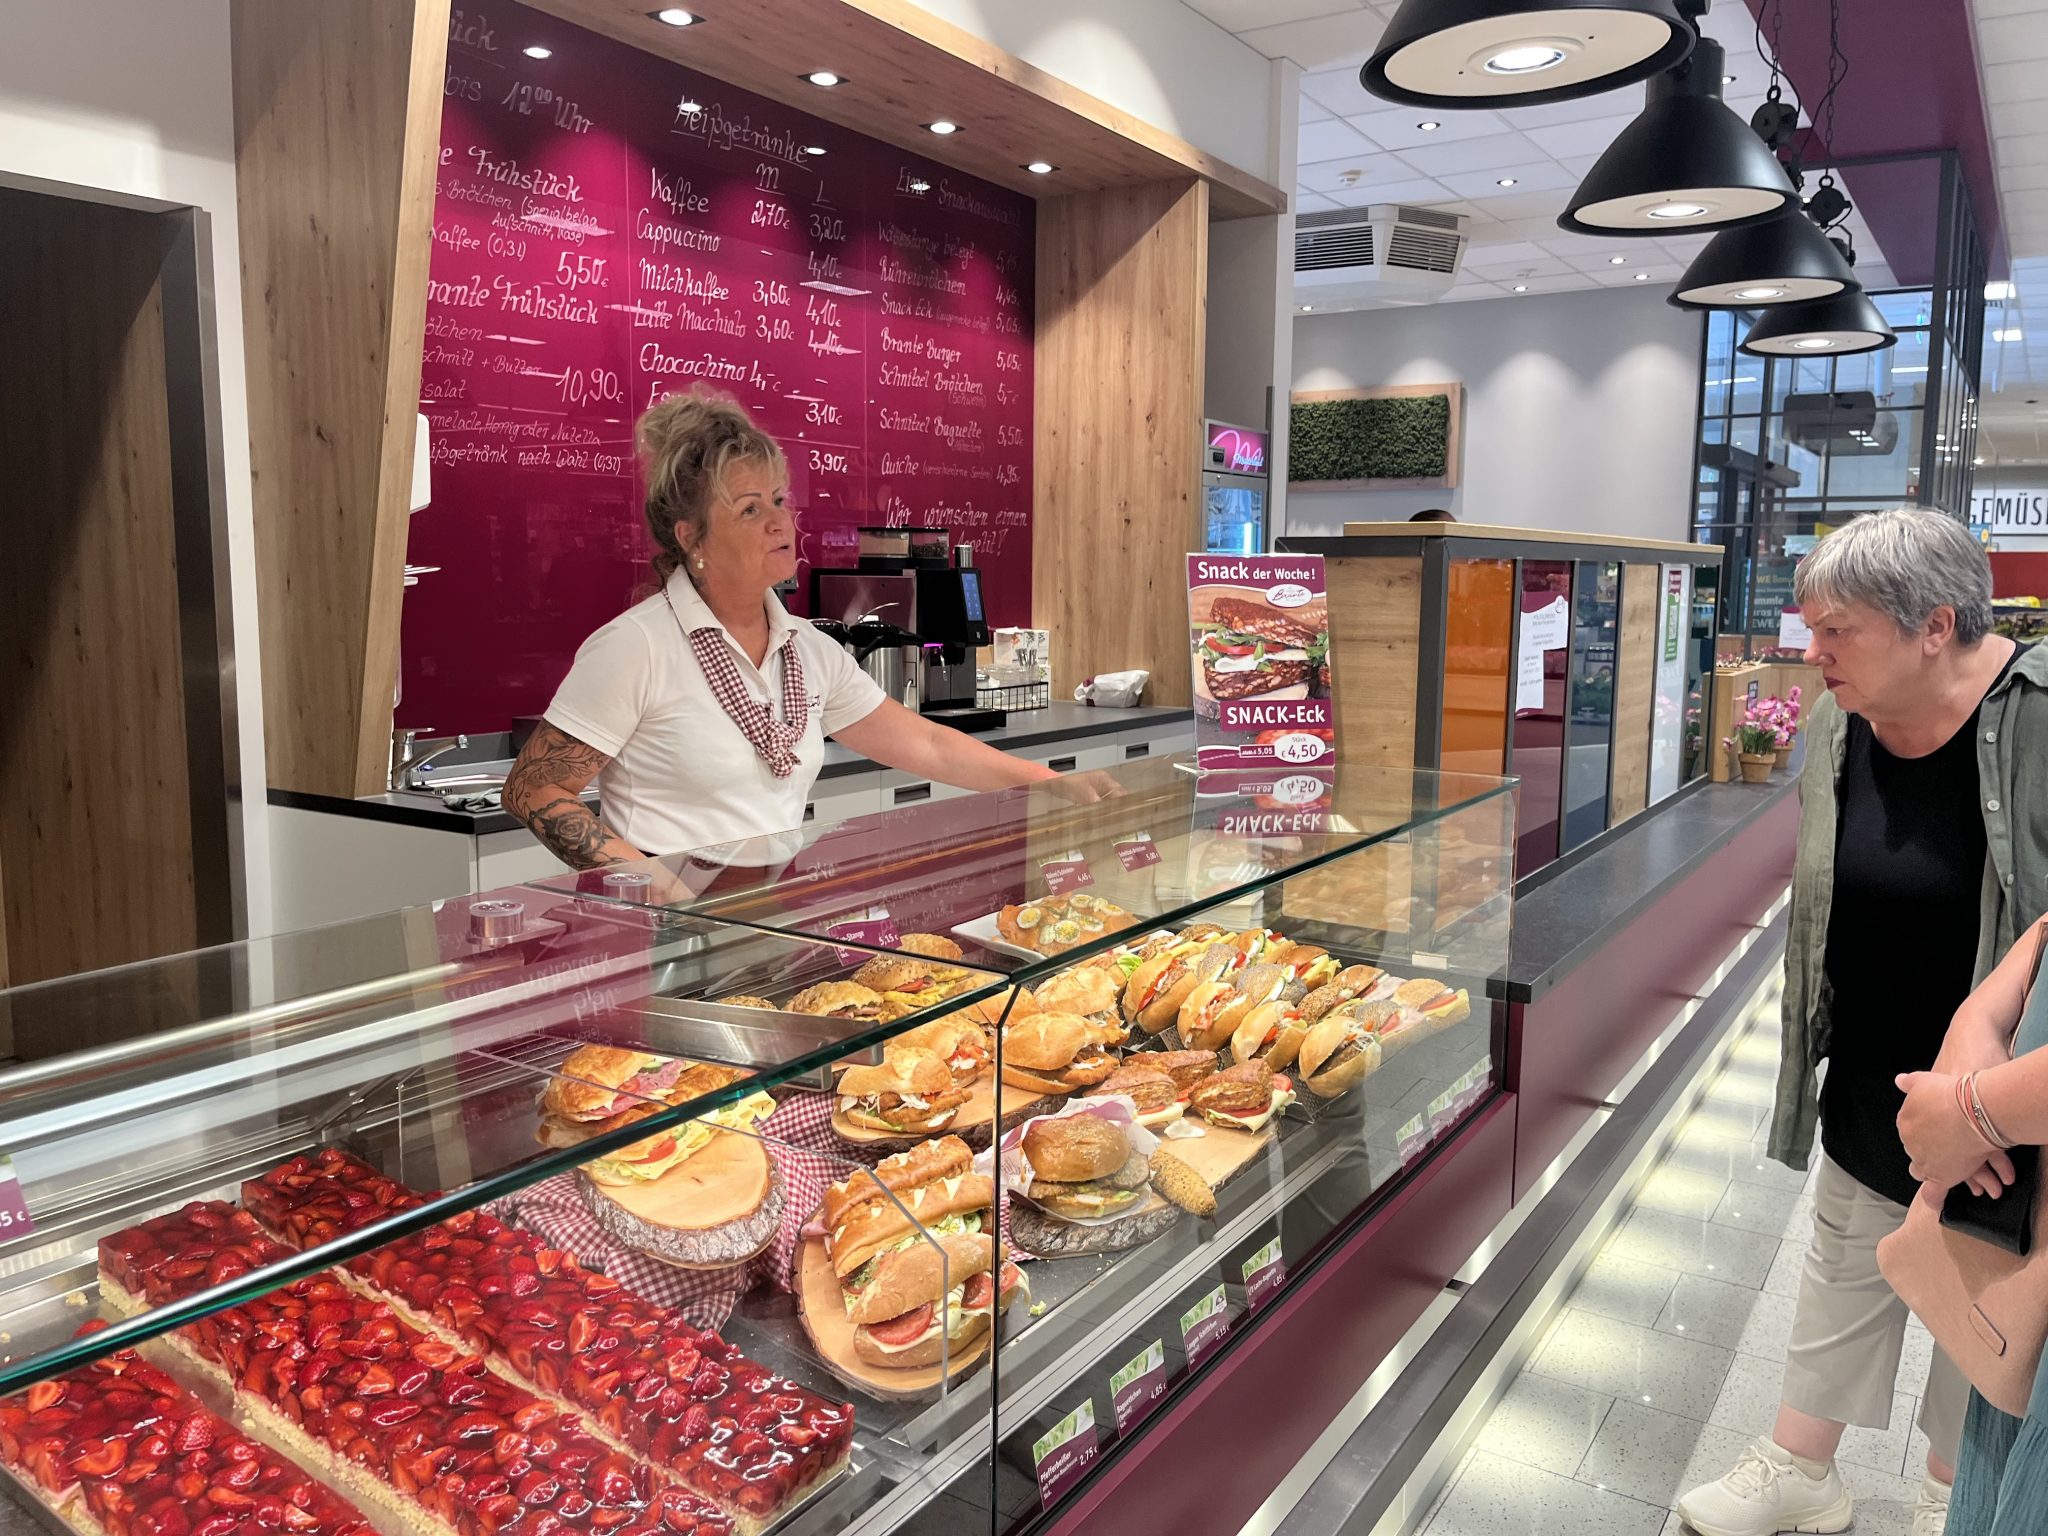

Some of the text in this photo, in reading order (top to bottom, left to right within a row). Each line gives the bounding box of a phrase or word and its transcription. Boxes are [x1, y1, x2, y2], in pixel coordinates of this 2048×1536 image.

[444, 65, 482, 102] bis
[553, 95, 595, 135] Uhr
[673, 95, 809, 164] Heißgetränke
[468, 145, 585, 203] Frühstück
[651, 166, 710, 216] Kaffee
[816, 179, 831, 203] L
[447, 179, 514, 211] Brötchen
[636, 207, 722, 255] Cappuccino
[639, 256, 729, 306] Milchkaffee
[493, 274, 600, 325] Frühstück
[880, 291, 912, 316] Snack
[914, 298, 933, 320] Eck
[633, 298, 673, 330] Latte
[676, 302, 747, 338] Macchiato
[493, 354, 544, 376] Butter
[639, 342, 747, 382] Chocochino
[880, 326, 924, 355] Brante
[926, 338, 962, 370] Burger
[879, 361, 930, 389] Schnitzel
[933, 371, 984, 396] Brötchen
[879, 407, 930, 434] Schnitzel
[933, 415, 983, 447] Baguette
[517, 445, 551, 466] nach
[556, 449, 588, 468] Wahl
[881, 451, 920, 476] Quiche
[885, 495, 1029, 530] Wir wünschen einen
[1970, 492, 2048, 526] GEMÜS
[1197, 560, 1250, 580] Snack
[1252, 567, 1272, 580] der
[1257, 747, 1273, 755] 5,05
[1288, 744, 1318, 760] 4,50
[878, 933, 895, 946] 5,15
[1150, 1383, 1163, 1400] 4,85
[1079, 1446, 1094, 1467] 2,75
